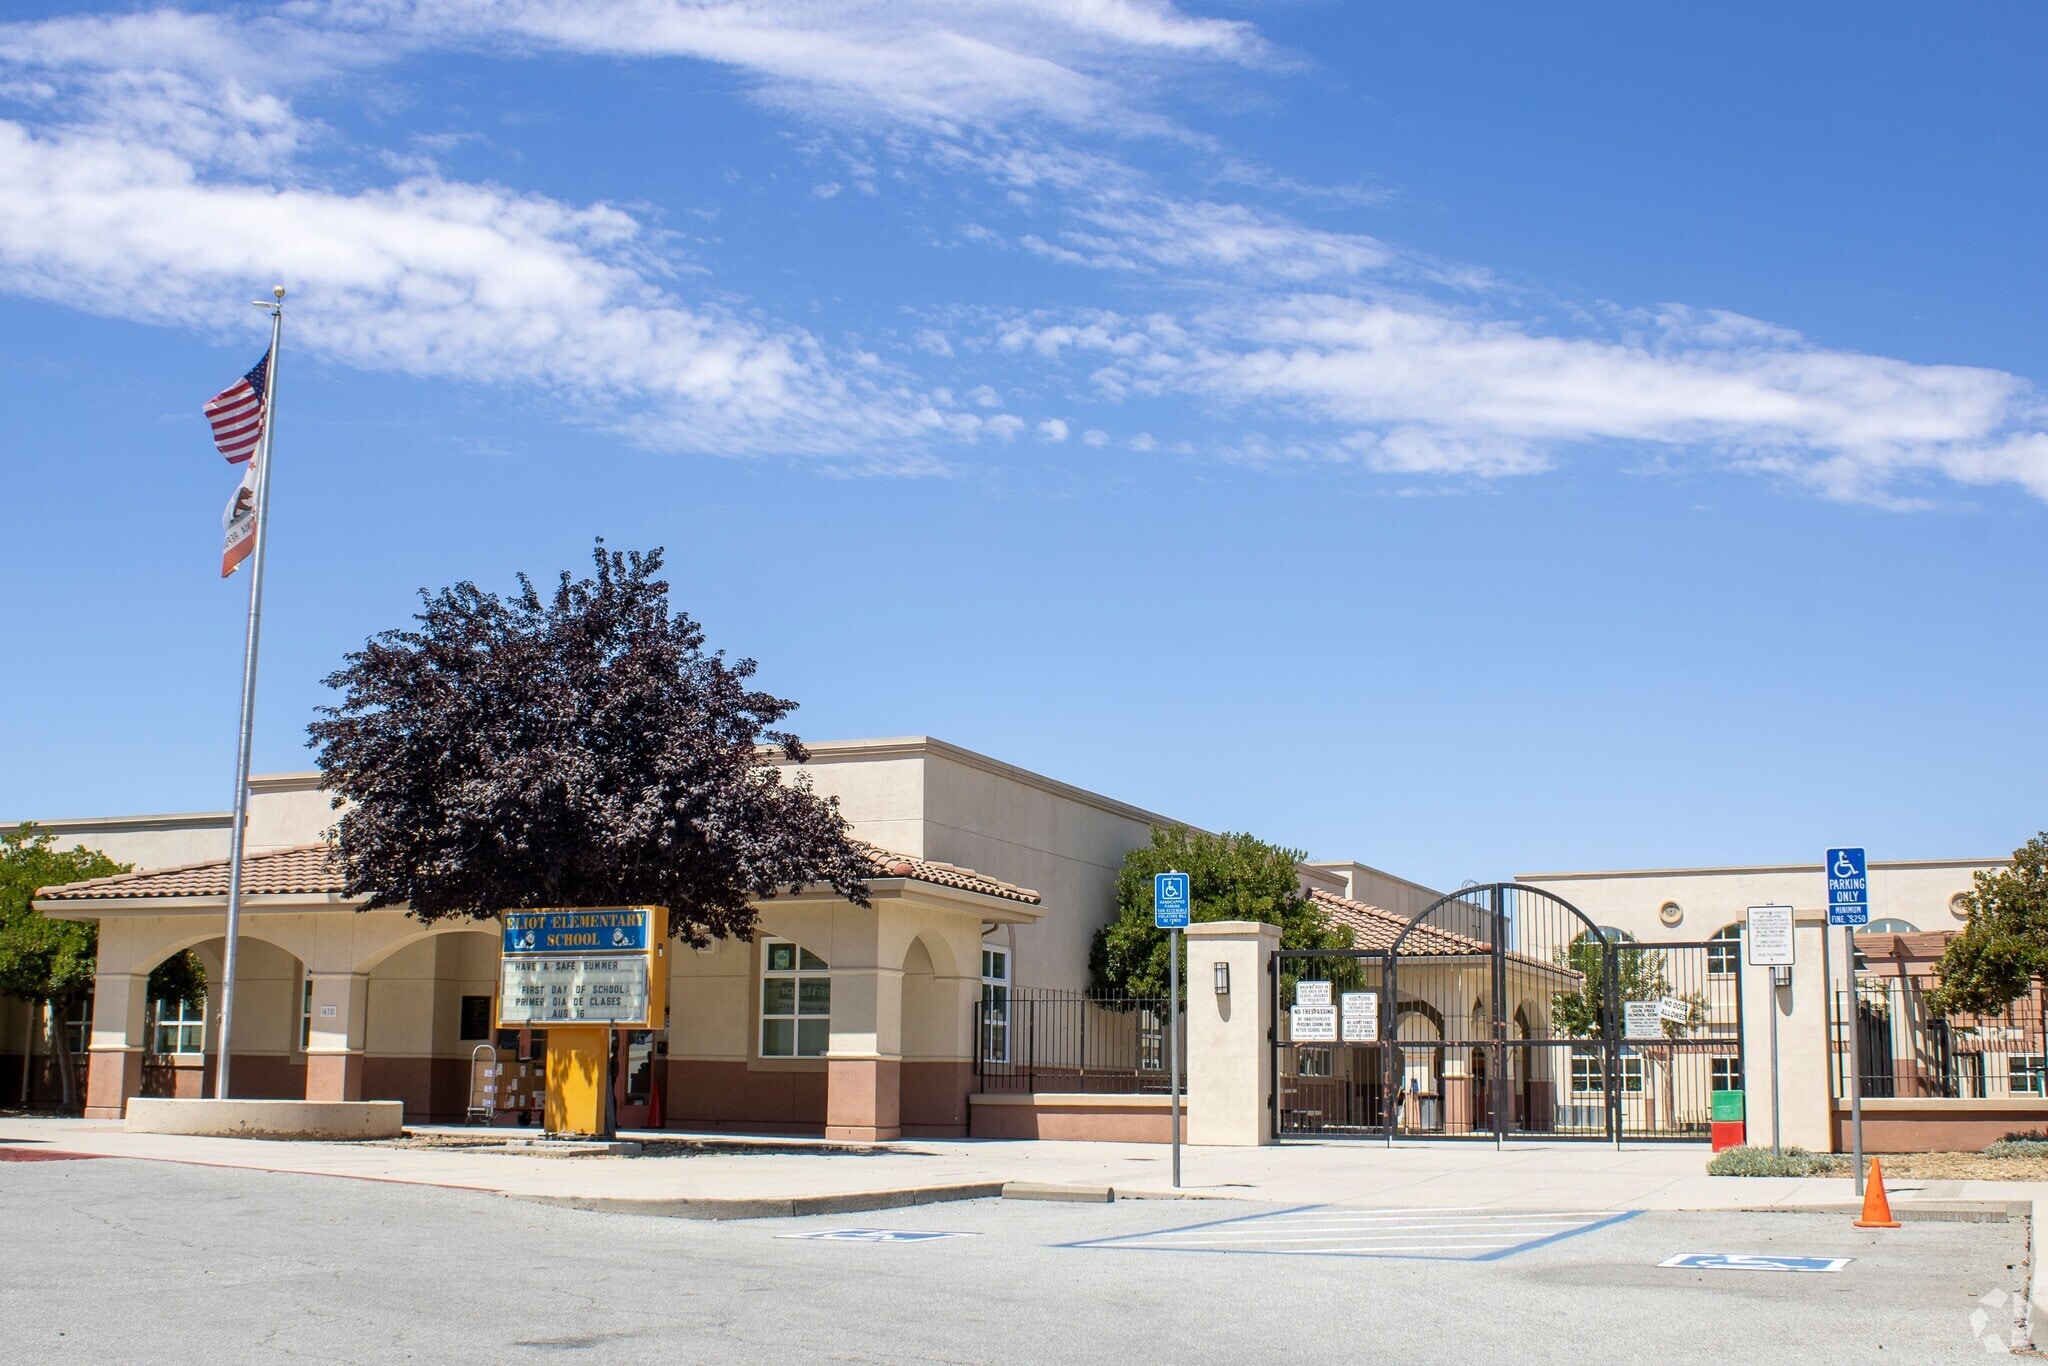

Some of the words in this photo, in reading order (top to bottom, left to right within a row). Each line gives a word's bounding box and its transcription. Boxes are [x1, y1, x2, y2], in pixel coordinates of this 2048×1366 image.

[1829, 878, 1865, 890] PARKING
[1837, 891, 1859, 902] ONLY
[1835, 906, 1862, 914] MINIMUM
[506, 917, 546, 930] ELIOT
[552, 913, 645, 929] ELEMENTARY
[1831, 915, 1846, 923] FINE
[546, 932, 601, 946] SCHOOL
[515, 961, 537, 971] HAVE
[543, 962, 549, 971] A
[555, 961, 576, 971] SAFE
[583, 961, 618, 970] SUMMER
[521, 985, 545, 995] FIRST
[551, 985, 568, 994] DAY
[575, 985, 586, 994] OF
[515, 997, 545, 1006] PRIMER
[552, 997, 567, 1006] DIA
[573, 997, 584, 1006] DE
[552, 1009, 569, 1018] AUG
[1661, 1009, 1687, 1020] ALLOWED
